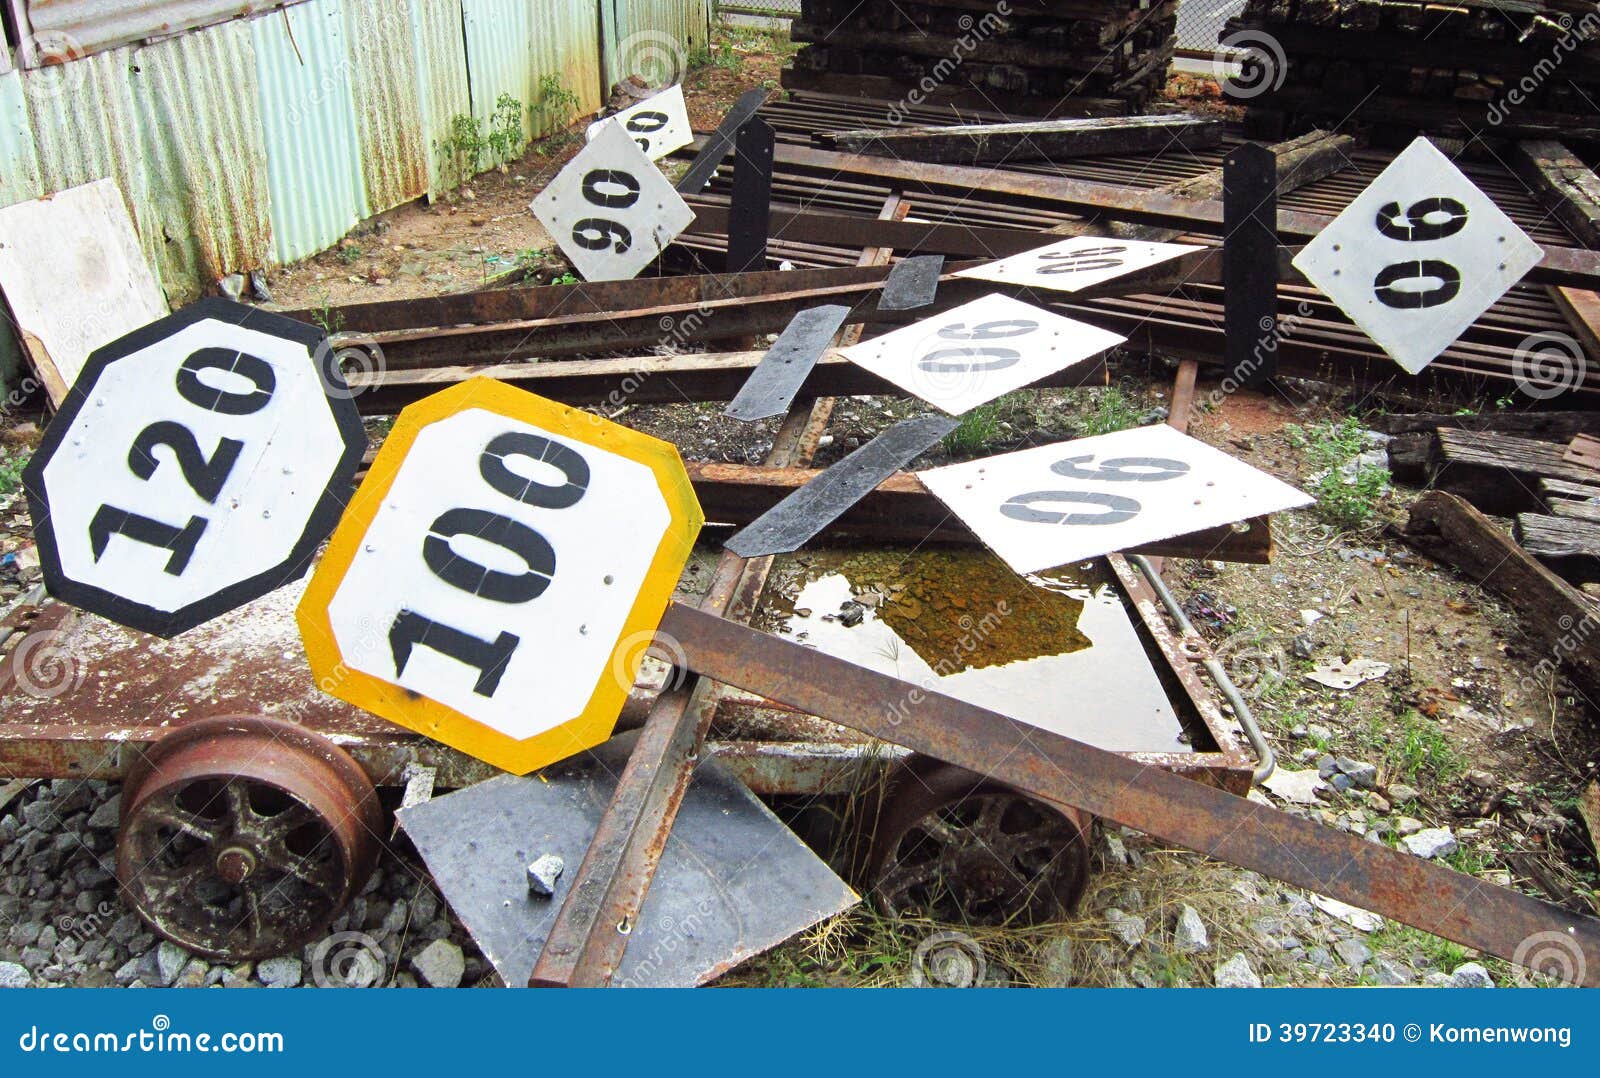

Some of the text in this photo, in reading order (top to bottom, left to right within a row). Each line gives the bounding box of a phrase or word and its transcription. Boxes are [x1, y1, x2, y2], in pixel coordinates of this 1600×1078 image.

[572, 168, 641, 254] 90
[88, 346, 277, 577] 120
[388, 431, 591, 698] 100
